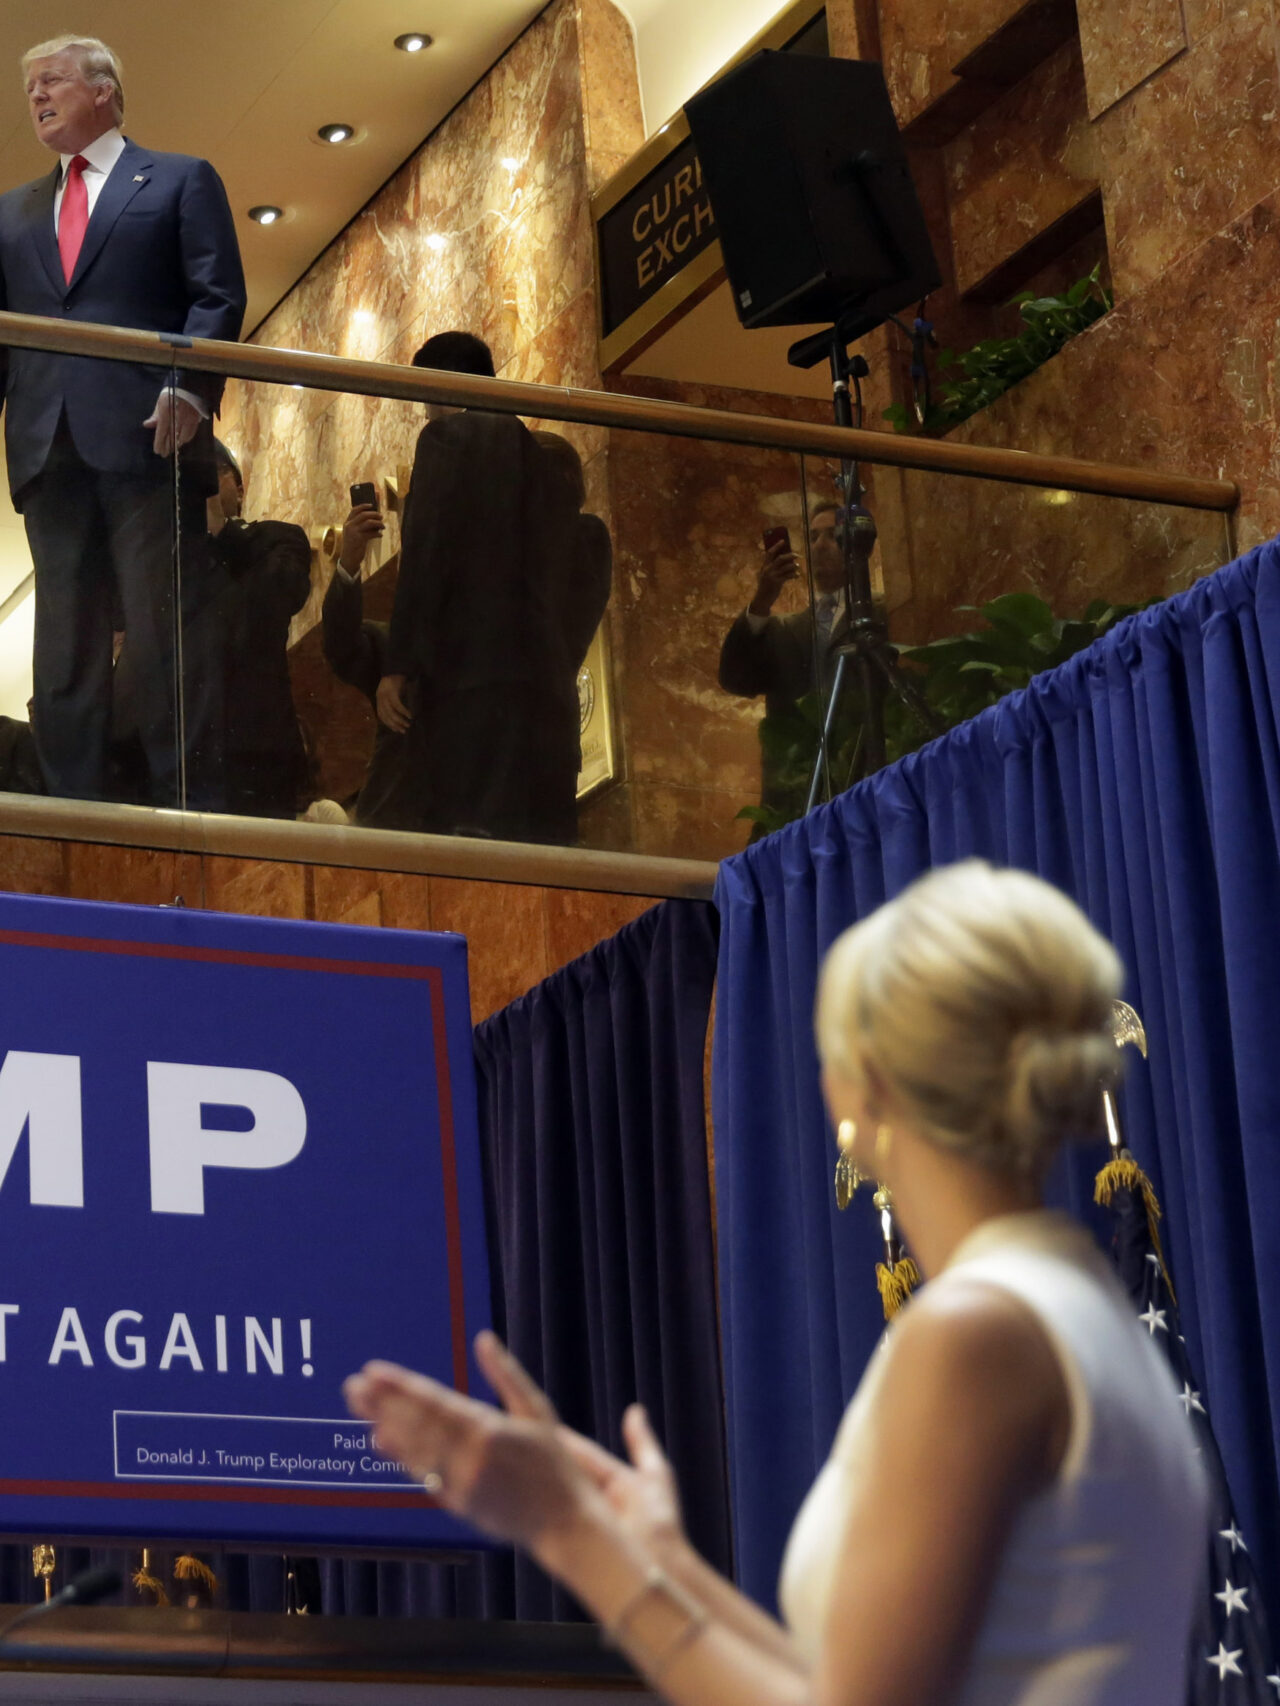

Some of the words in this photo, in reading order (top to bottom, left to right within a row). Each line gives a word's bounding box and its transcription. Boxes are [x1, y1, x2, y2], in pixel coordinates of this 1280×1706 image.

[48, 1307, 313, 1378] AGAIN!
[333, 1433, 367, 1450] Paid
[136, 1447, 193, 1465] Donald
[197, 1449, 211, 1466] J.
[215, 1449, 266, 1473] Trump
[269, 1452, 356, 1476] Exploratory
